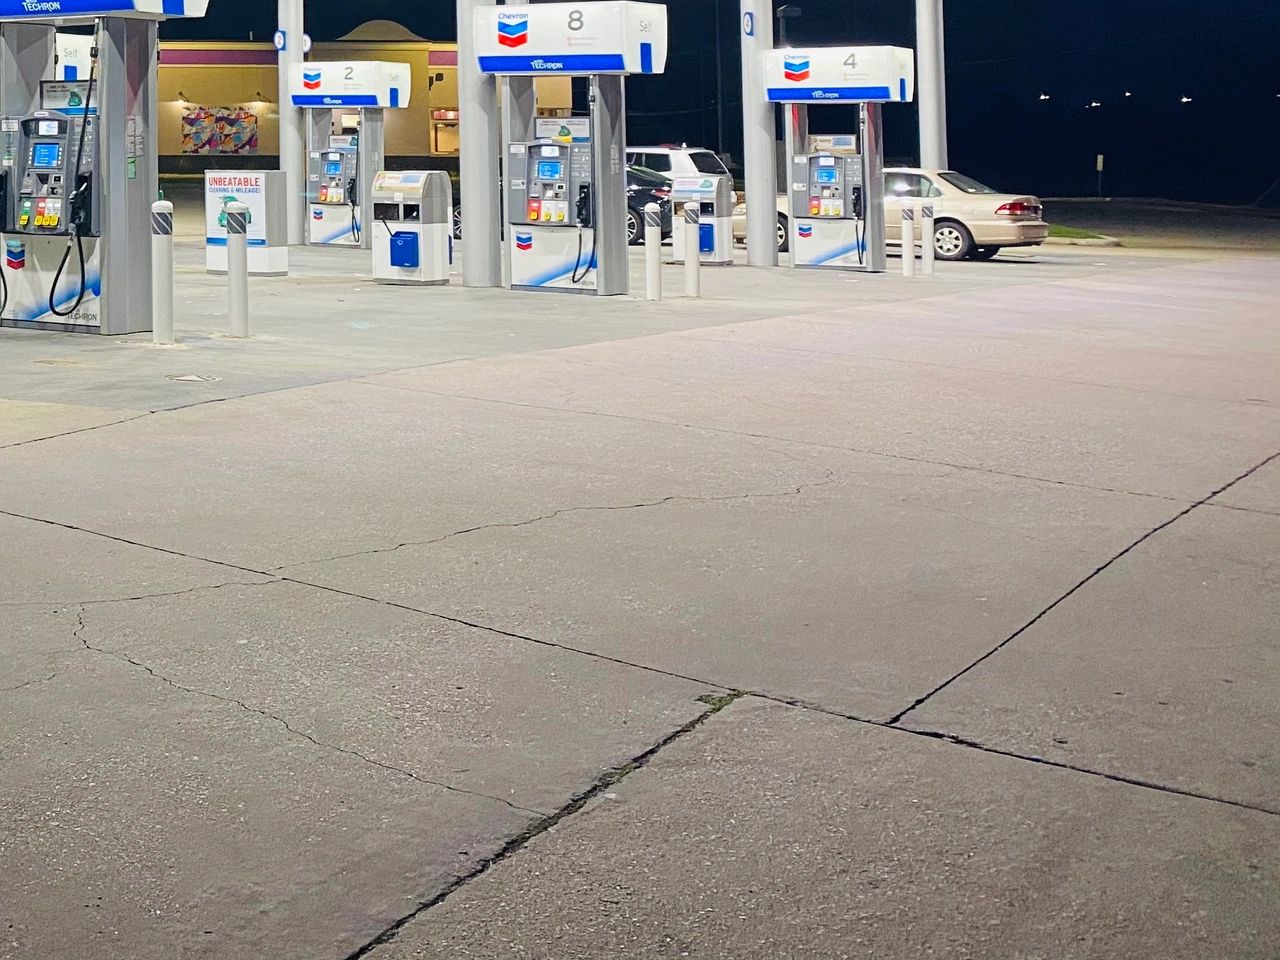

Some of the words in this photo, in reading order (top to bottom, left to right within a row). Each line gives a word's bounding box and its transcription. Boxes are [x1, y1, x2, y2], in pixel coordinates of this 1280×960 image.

[22, 1, 60, 12] TECHRON
[568, 10, 584, 31] 8
[843, 53, 858, 69] 4
[344, 67, 354, 80] 2
[208, 177, 260, 187] UNBEATABLE
